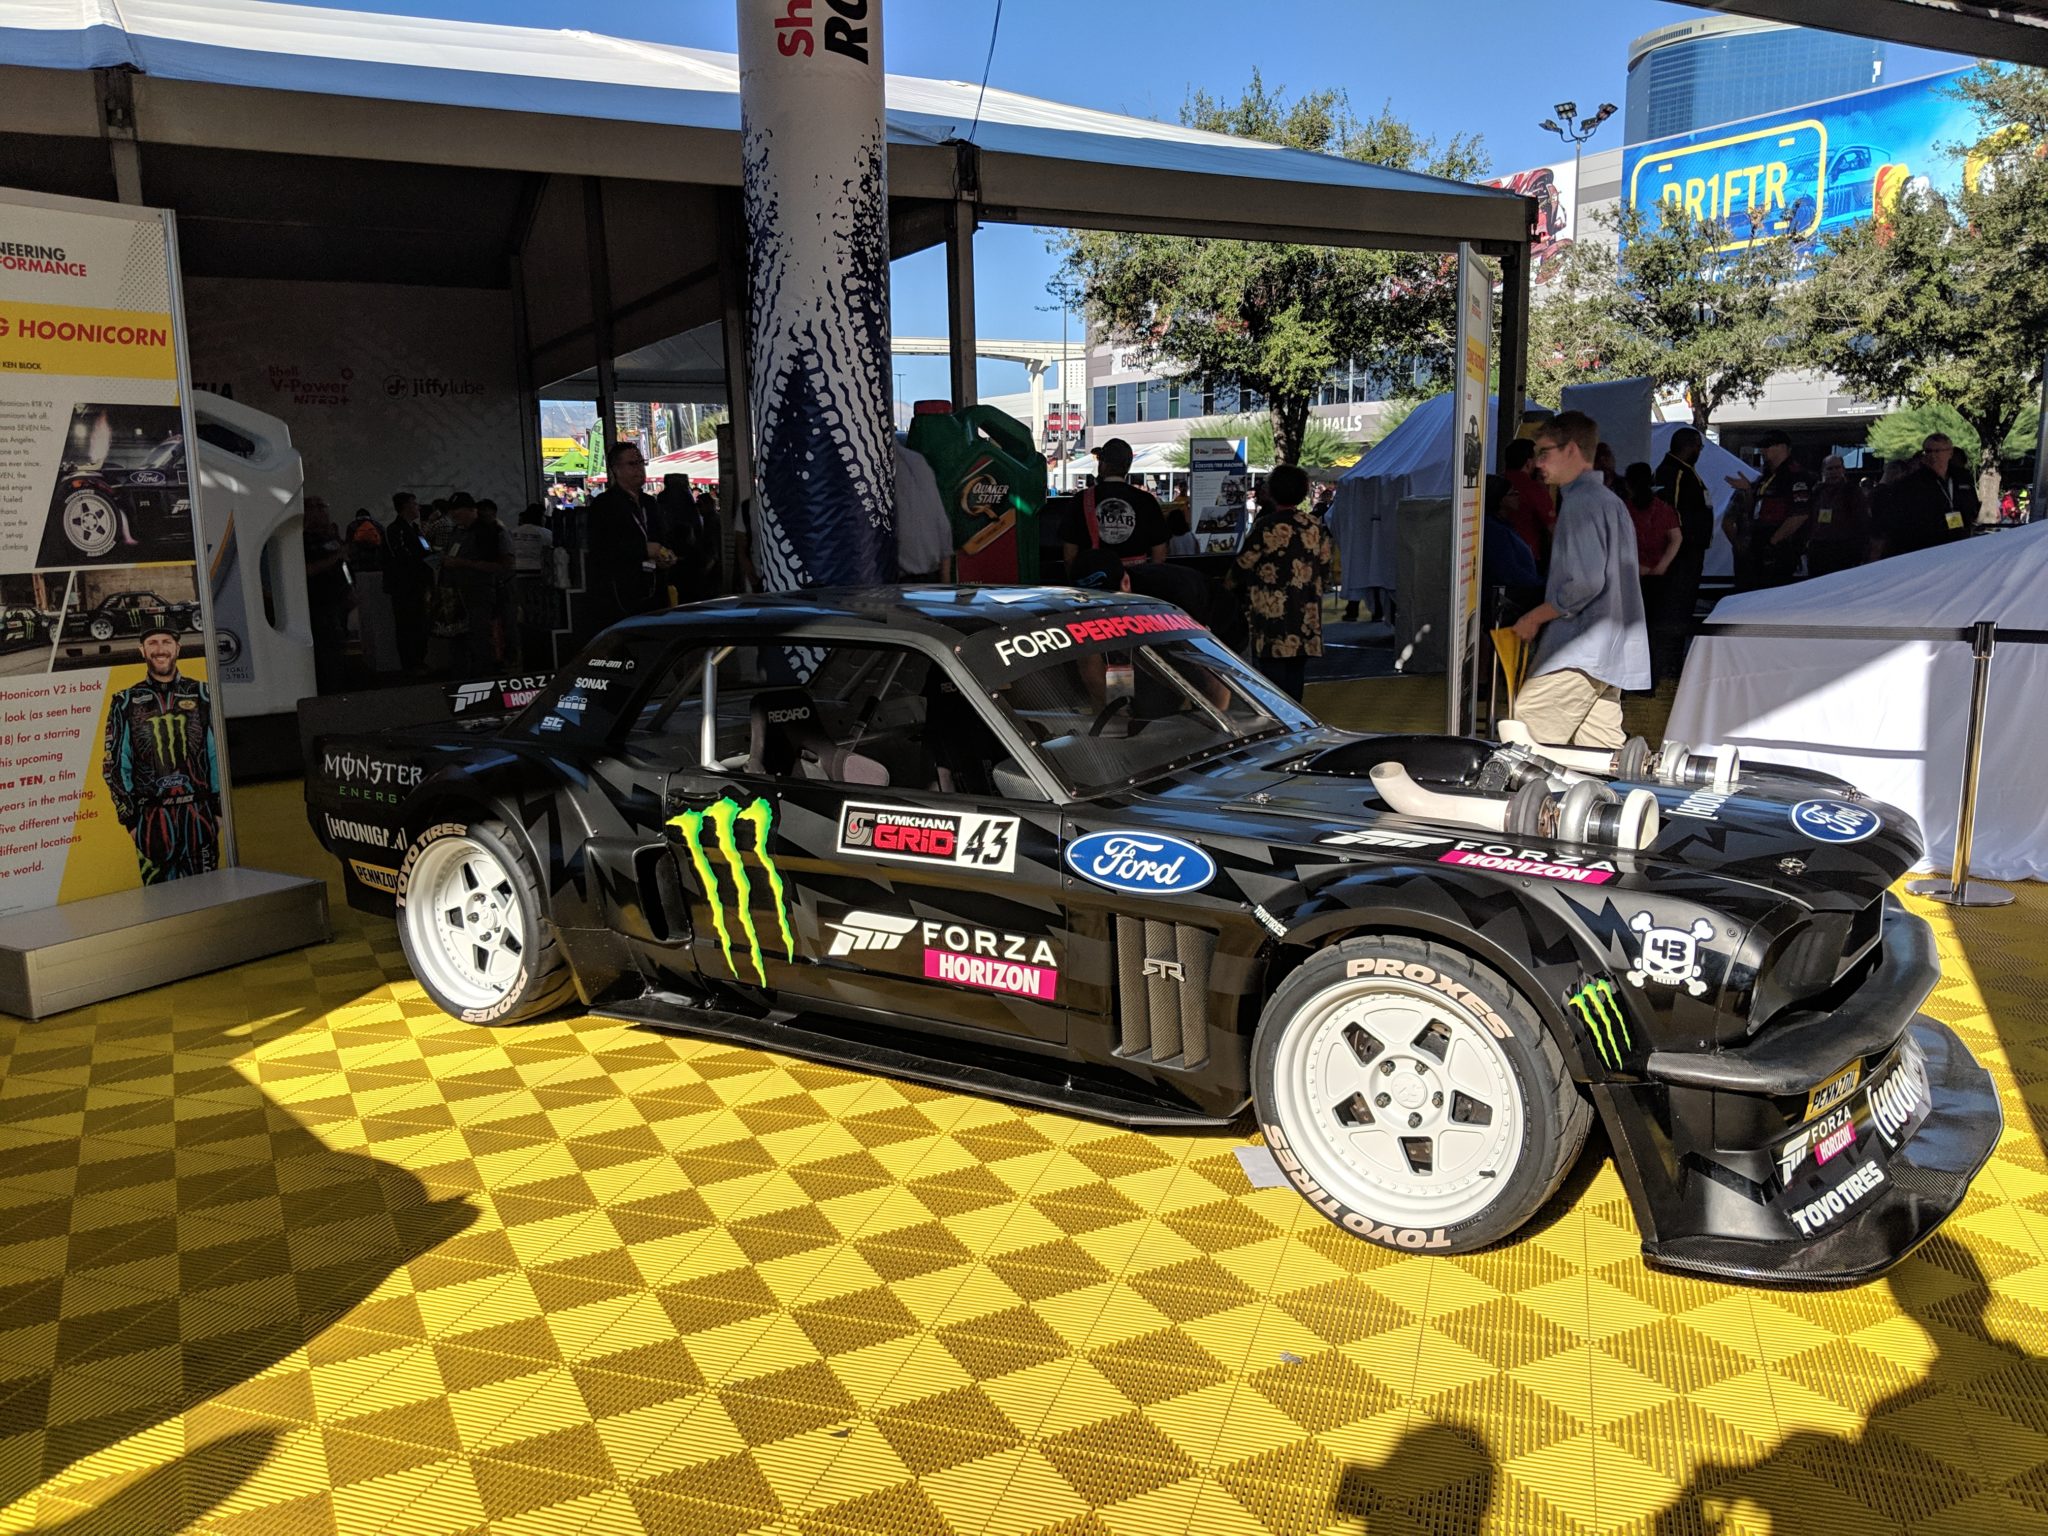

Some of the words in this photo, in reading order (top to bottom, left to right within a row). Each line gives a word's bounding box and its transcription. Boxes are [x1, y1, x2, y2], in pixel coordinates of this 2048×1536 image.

[774, 0, 815, 58] Sh
[1662, 161, 1788, 229] DR1FTR
[18, 318, 167, 347] HOONICORN
[2, 361, 17, 369] KEN
[19, 362, 42, 370] BLOCK
[1322, 415, 1363, 432] HALLS
[972, 482, 1010, 495] QUAKER
[976, 494, 1004, 504] STATE
[994, 627, 1072, 667] FORD
[0, 688, 50, 700] Hoonicorn
[53, 684, 67, 695] V2
[70, 684, 77, 693] is
[80, 680, 102, 692] back
[498, 674, 557, 693] FORZ
[574, 677, 611, 691] SONAX
[558, 694, 589, 704] GoPro
[5, 711, 26, 722] look
[29, 709, 43, 721] (as
[46, 708, 68, 718] seen
[71, 704, 91, 715] here
[767, 706, 811, 724] RECARO
[17, 732, 31, 743] for
[44, 728, 80, 739] starring
[16, 752, 63, 767] upcoming
[324, 752, 423, 787] MONSTER
[19, 774, 46, 787] TEN,
[59, 770, 76, 781] film
[0, 801, 26, 814] years
[28, 798, 38, 808] in
[41, 794, 56, 806] the
[58, 790, 97, 803] making,
[338, 785, 406, 804] ENERG
[0, 823, 16, 834] five
[19, 817, 61, 831] different
[62, 809, 99, 824] vehicles
[876, 813, 956, 831] GYMKHANA
[41, 834, 83, 849] locations
[960, 818, 1015, 865] 43
[13, 860, 45, 876] world.
[395, 843, 421, 908] TOYO
[416, 822, 469, 848] TIRES
[1453, 840, 1617, 873] FORZA
[1456, 853, 1592, 882] HORIZON
[922, 921, 1058, 967] FORZA
[1650, 937, 1688, 962] 43
[939, 952, 1041, 995] HORIZON
[461, 965, 529, 1023] PROXES
[1346, 958, 1515, 1040] PROXES
[1809, 1069, 1858, 1114] PENNZOIL
[1810, 1104, 1852, 1144] FORZA
[1819, 1129, 1852, 1160] HORIZON
[1263, 1123, 1348, 1213] TIRES
[1791, 1190, 1844, 1235] TOYO
[1836, 1160, 1885, 1207] TIRES
[1343, 1212, 1452, 1249] TOYO
